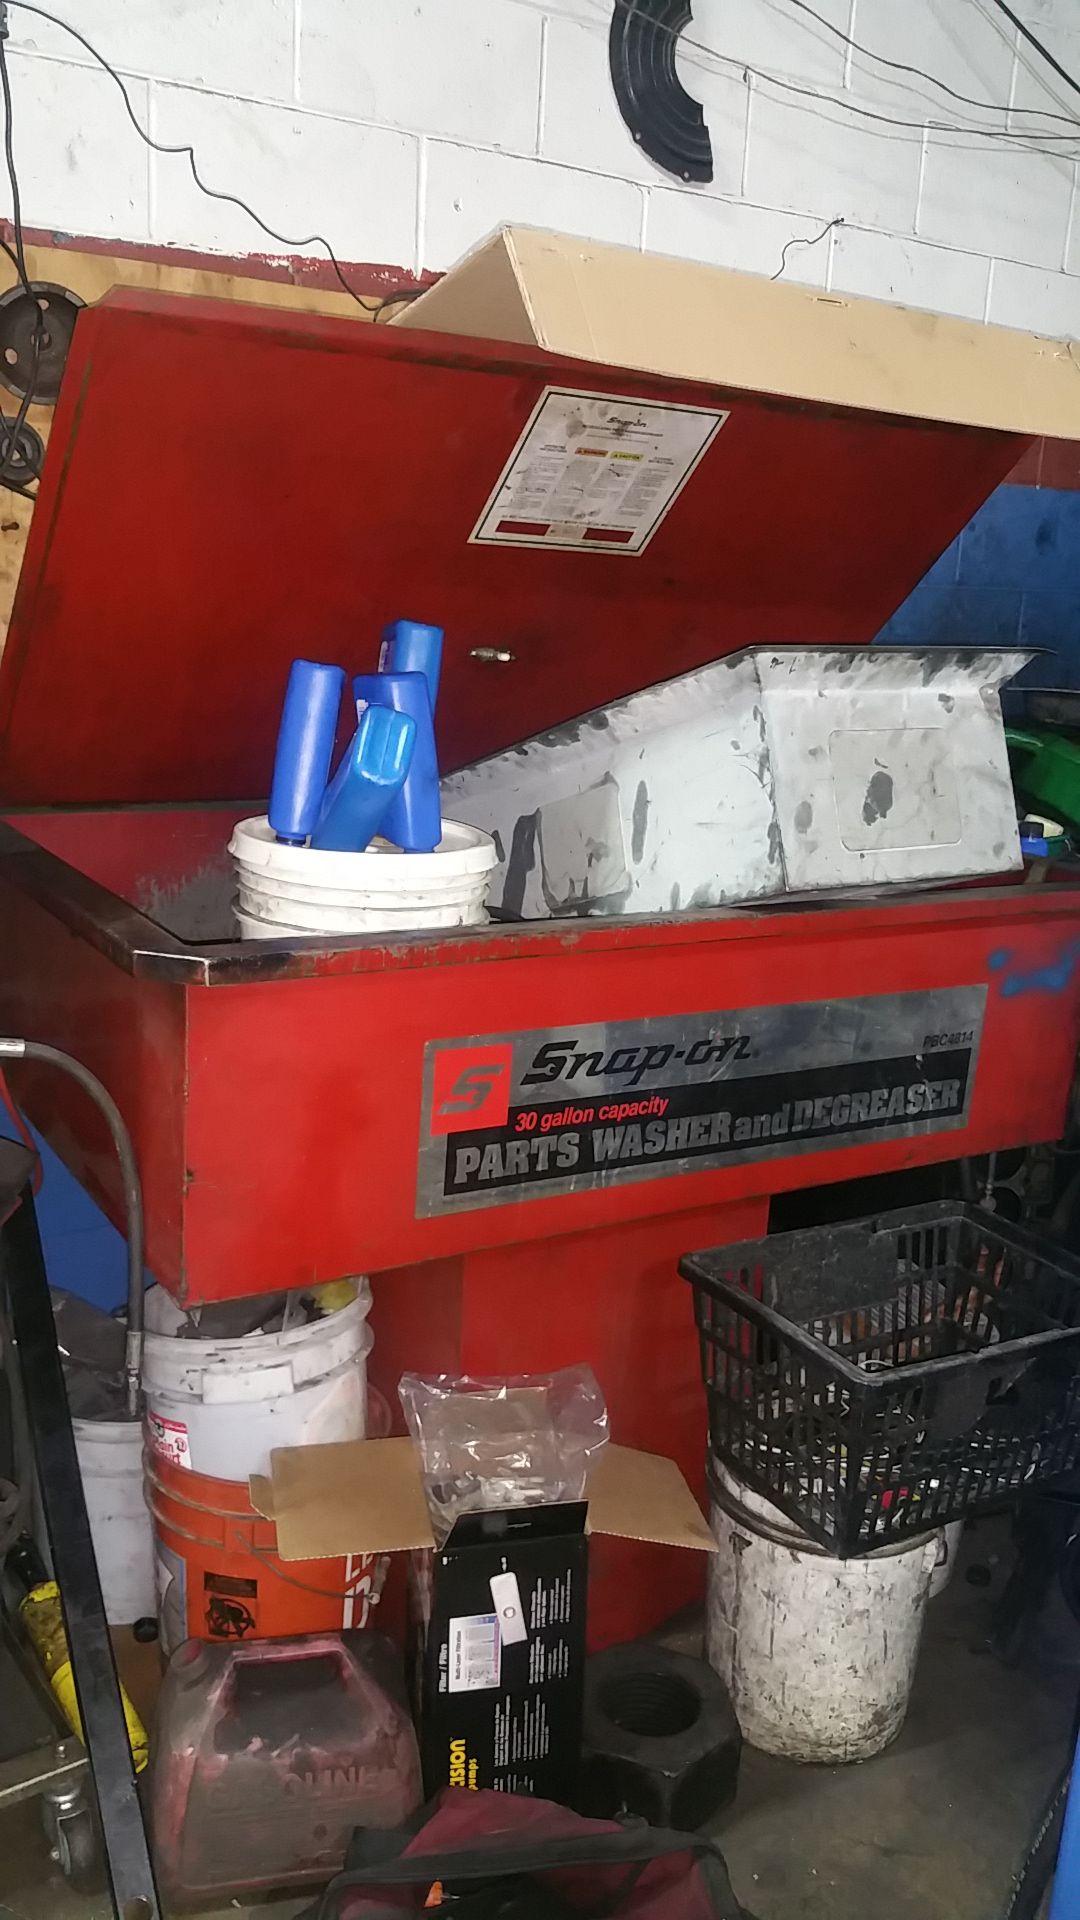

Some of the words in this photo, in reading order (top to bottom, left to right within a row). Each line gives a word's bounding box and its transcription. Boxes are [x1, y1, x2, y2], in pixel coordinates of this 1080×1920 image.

[519, 1034, 752, 1086] Snap-on
[453, 1133, 580, 1184] PARTS
[591, 1111, 733, 1163] WASHER
[733, 1103, 790, 1142] and
[790, 1078, 961, 1132] DEGREASER
[514, 1112, 538, 1133] 30
[539, 1104, 596, 1132] gallon
[599, 1096, 669, 1127] capacity
